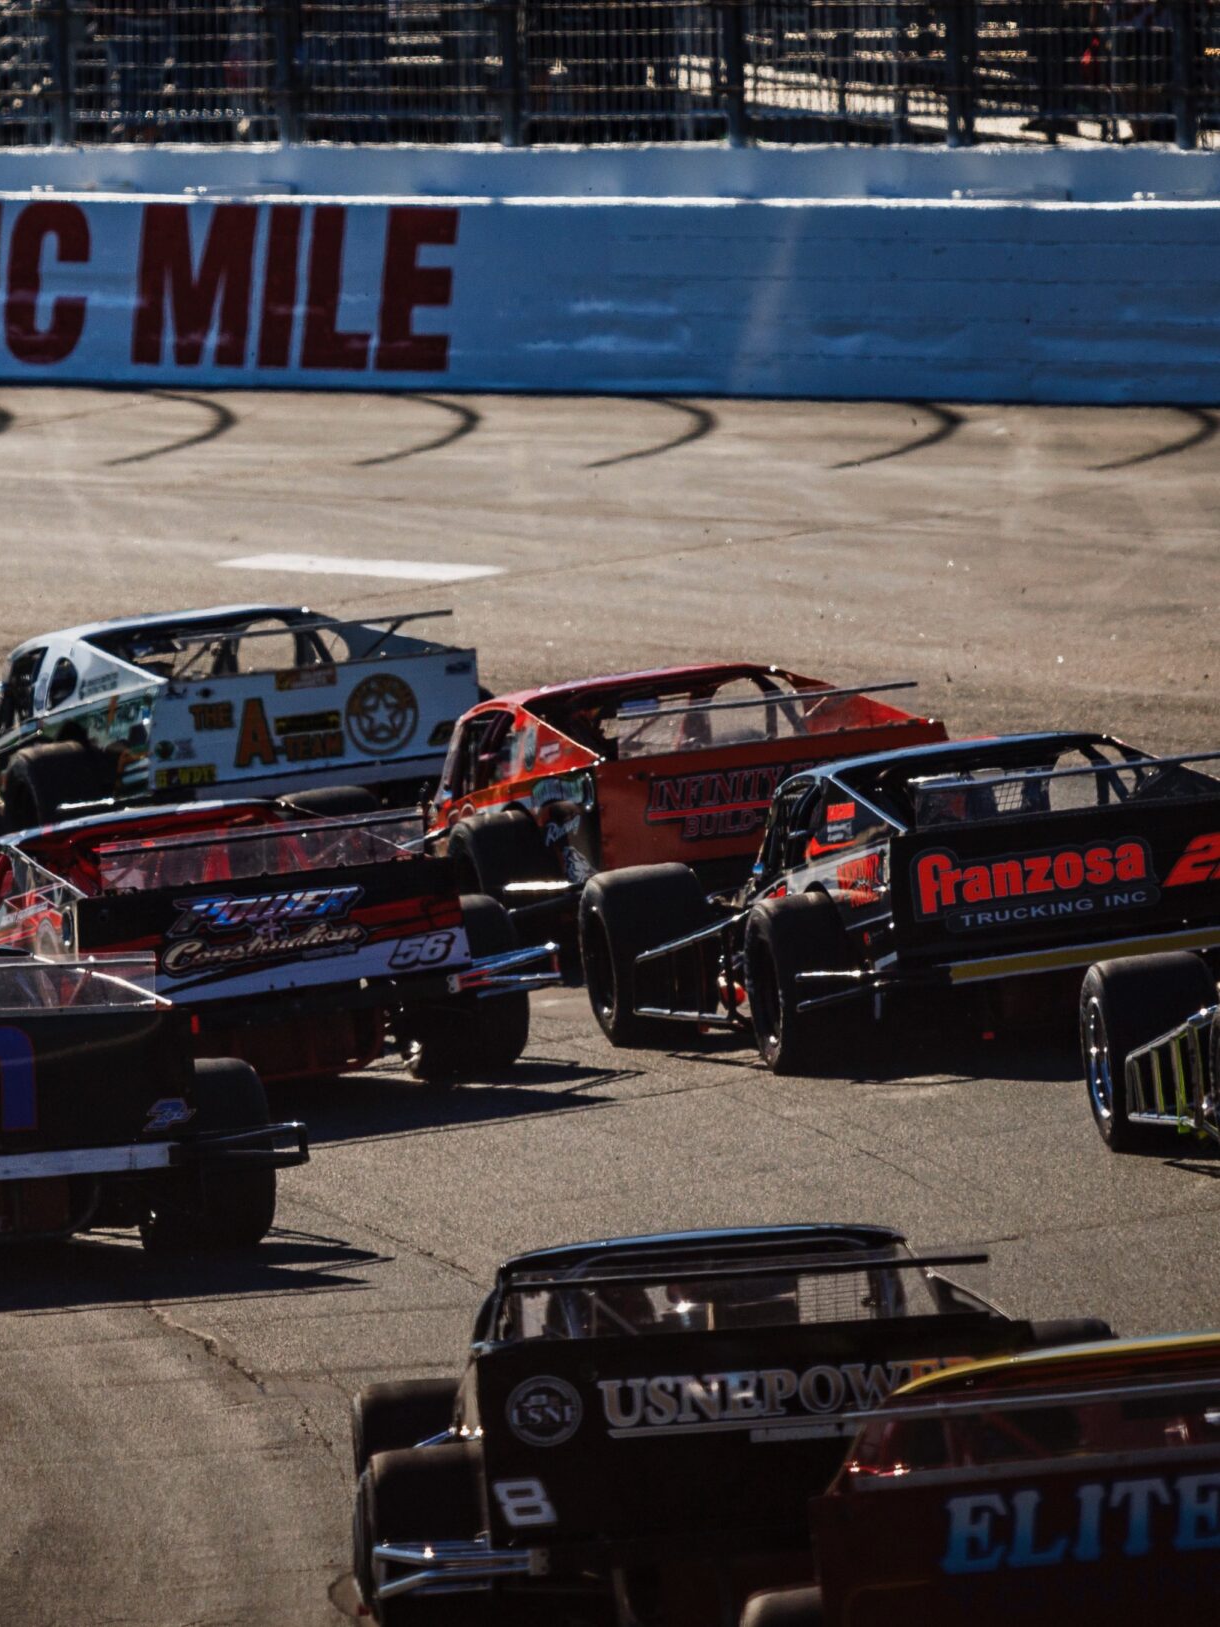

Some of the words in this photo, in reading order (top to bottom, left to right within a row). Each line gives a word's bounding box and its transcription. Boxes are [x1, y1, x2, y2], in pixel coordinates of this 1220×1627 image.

[130, 202, 461, 373] MILE
[189, 701, 234, 732] THE
[1162, 831, 1220, 888] 2
[960, 897, 1094, 928] TRUCKING
[1103, 889, 1148, 908] INC
[388, 933, 455, 970] 56
[596, 1356, 980, 1429] USNEPOW
[491, 1476, 559, 1530] 8
[941, 1472, 1220, 1576] ELITE
